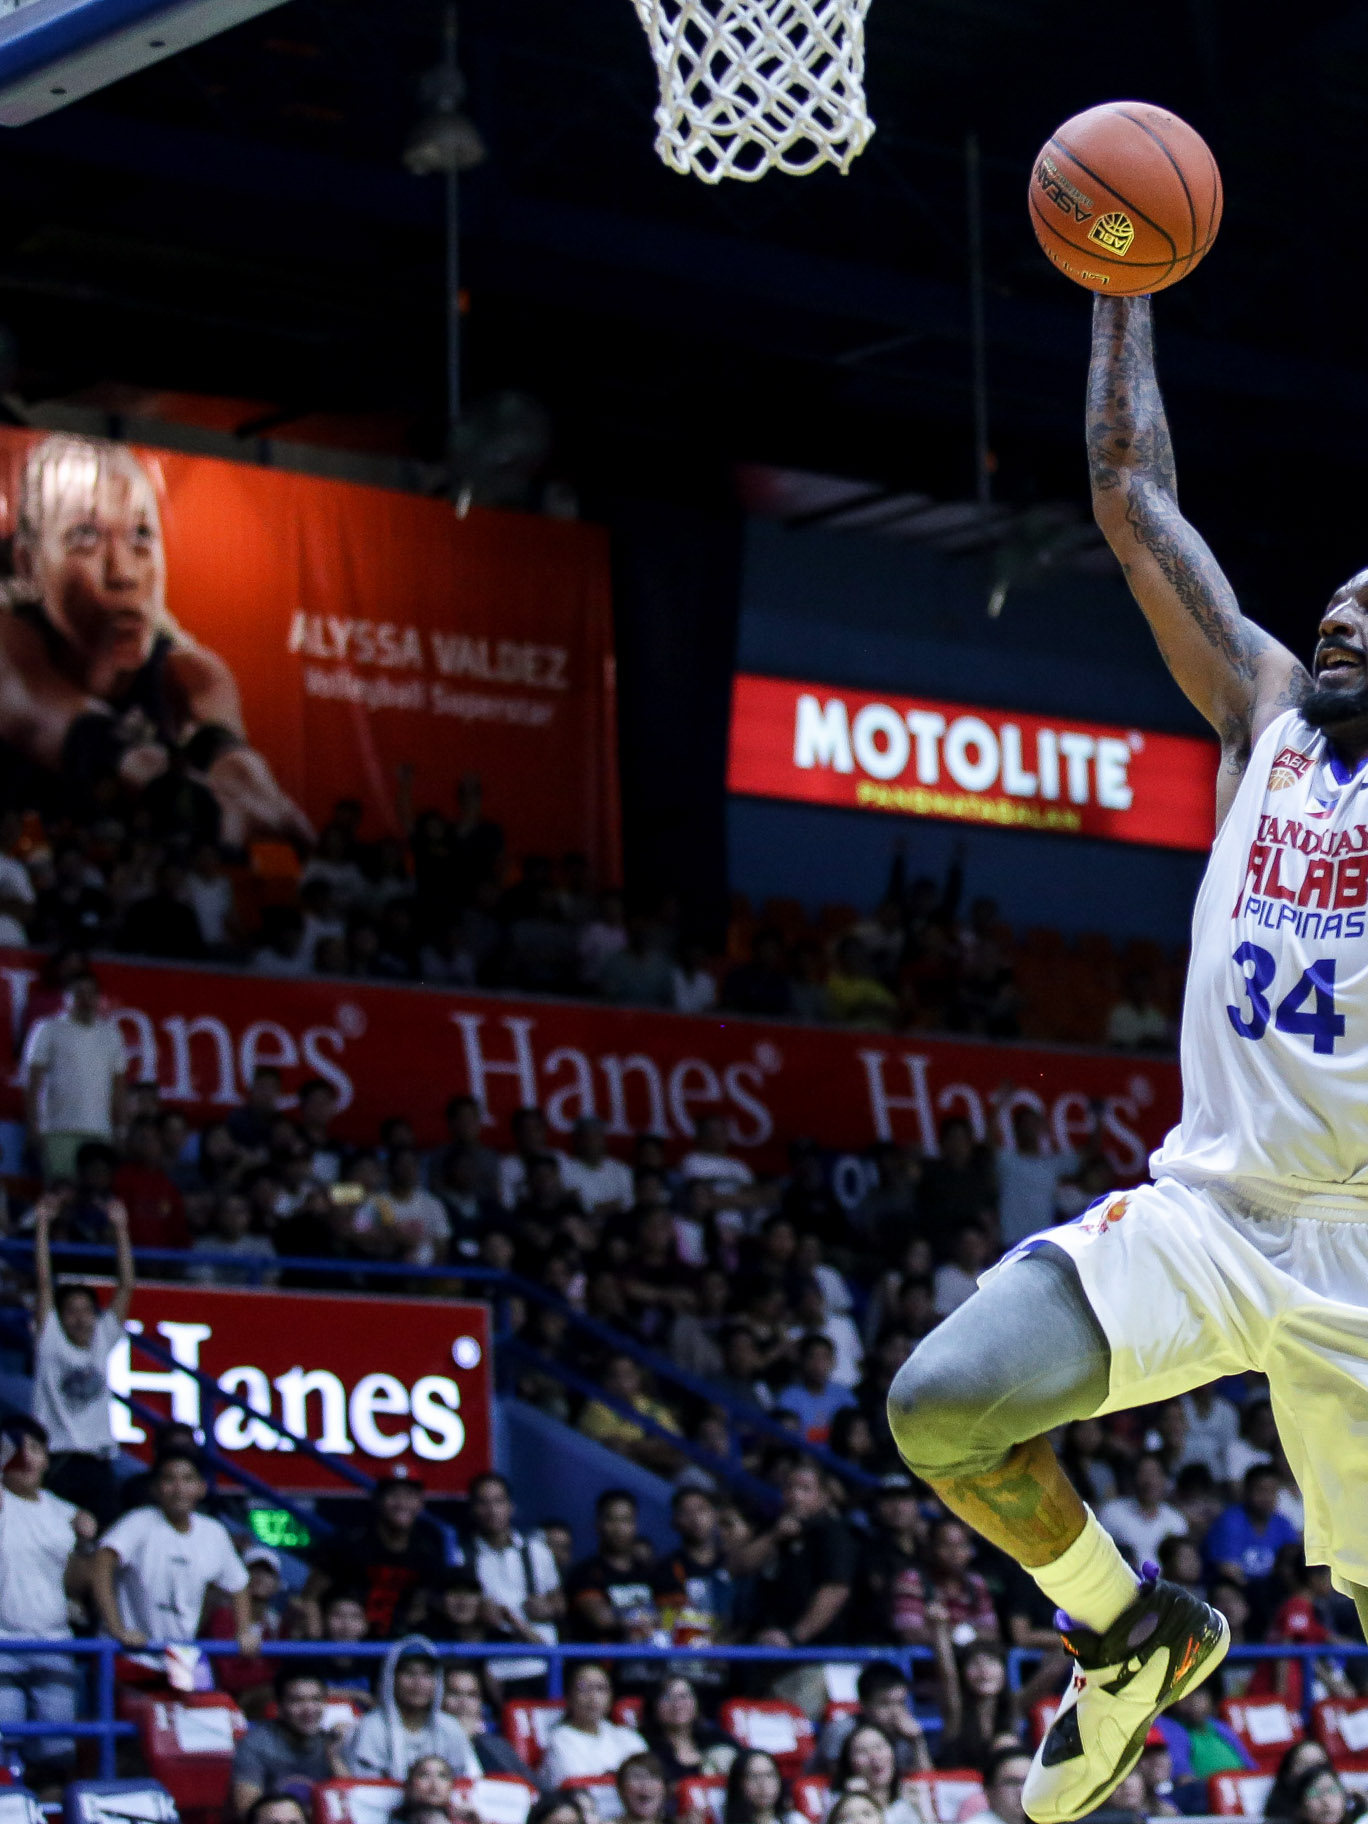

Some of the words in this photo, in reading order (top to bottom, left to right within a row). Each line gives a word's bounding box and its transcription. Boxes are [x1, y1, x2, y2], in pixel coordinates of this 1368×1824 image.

[1035, 160, 1092, 222] ASEAN
[1098, 226, 1126, 248] ABL
[288, 609, 424, 670] ALYSSA
[431, 631, 569, 690] VALDEZ
[794, 693, 1134, 812] MOTOLITE
[1277, 753, 1307, 774] ABL
[1226, 941, 1345, 1055] 34
[451, 1010, 776, 1148] Hanes
[106, 1320, 465, 1462] Hanes
